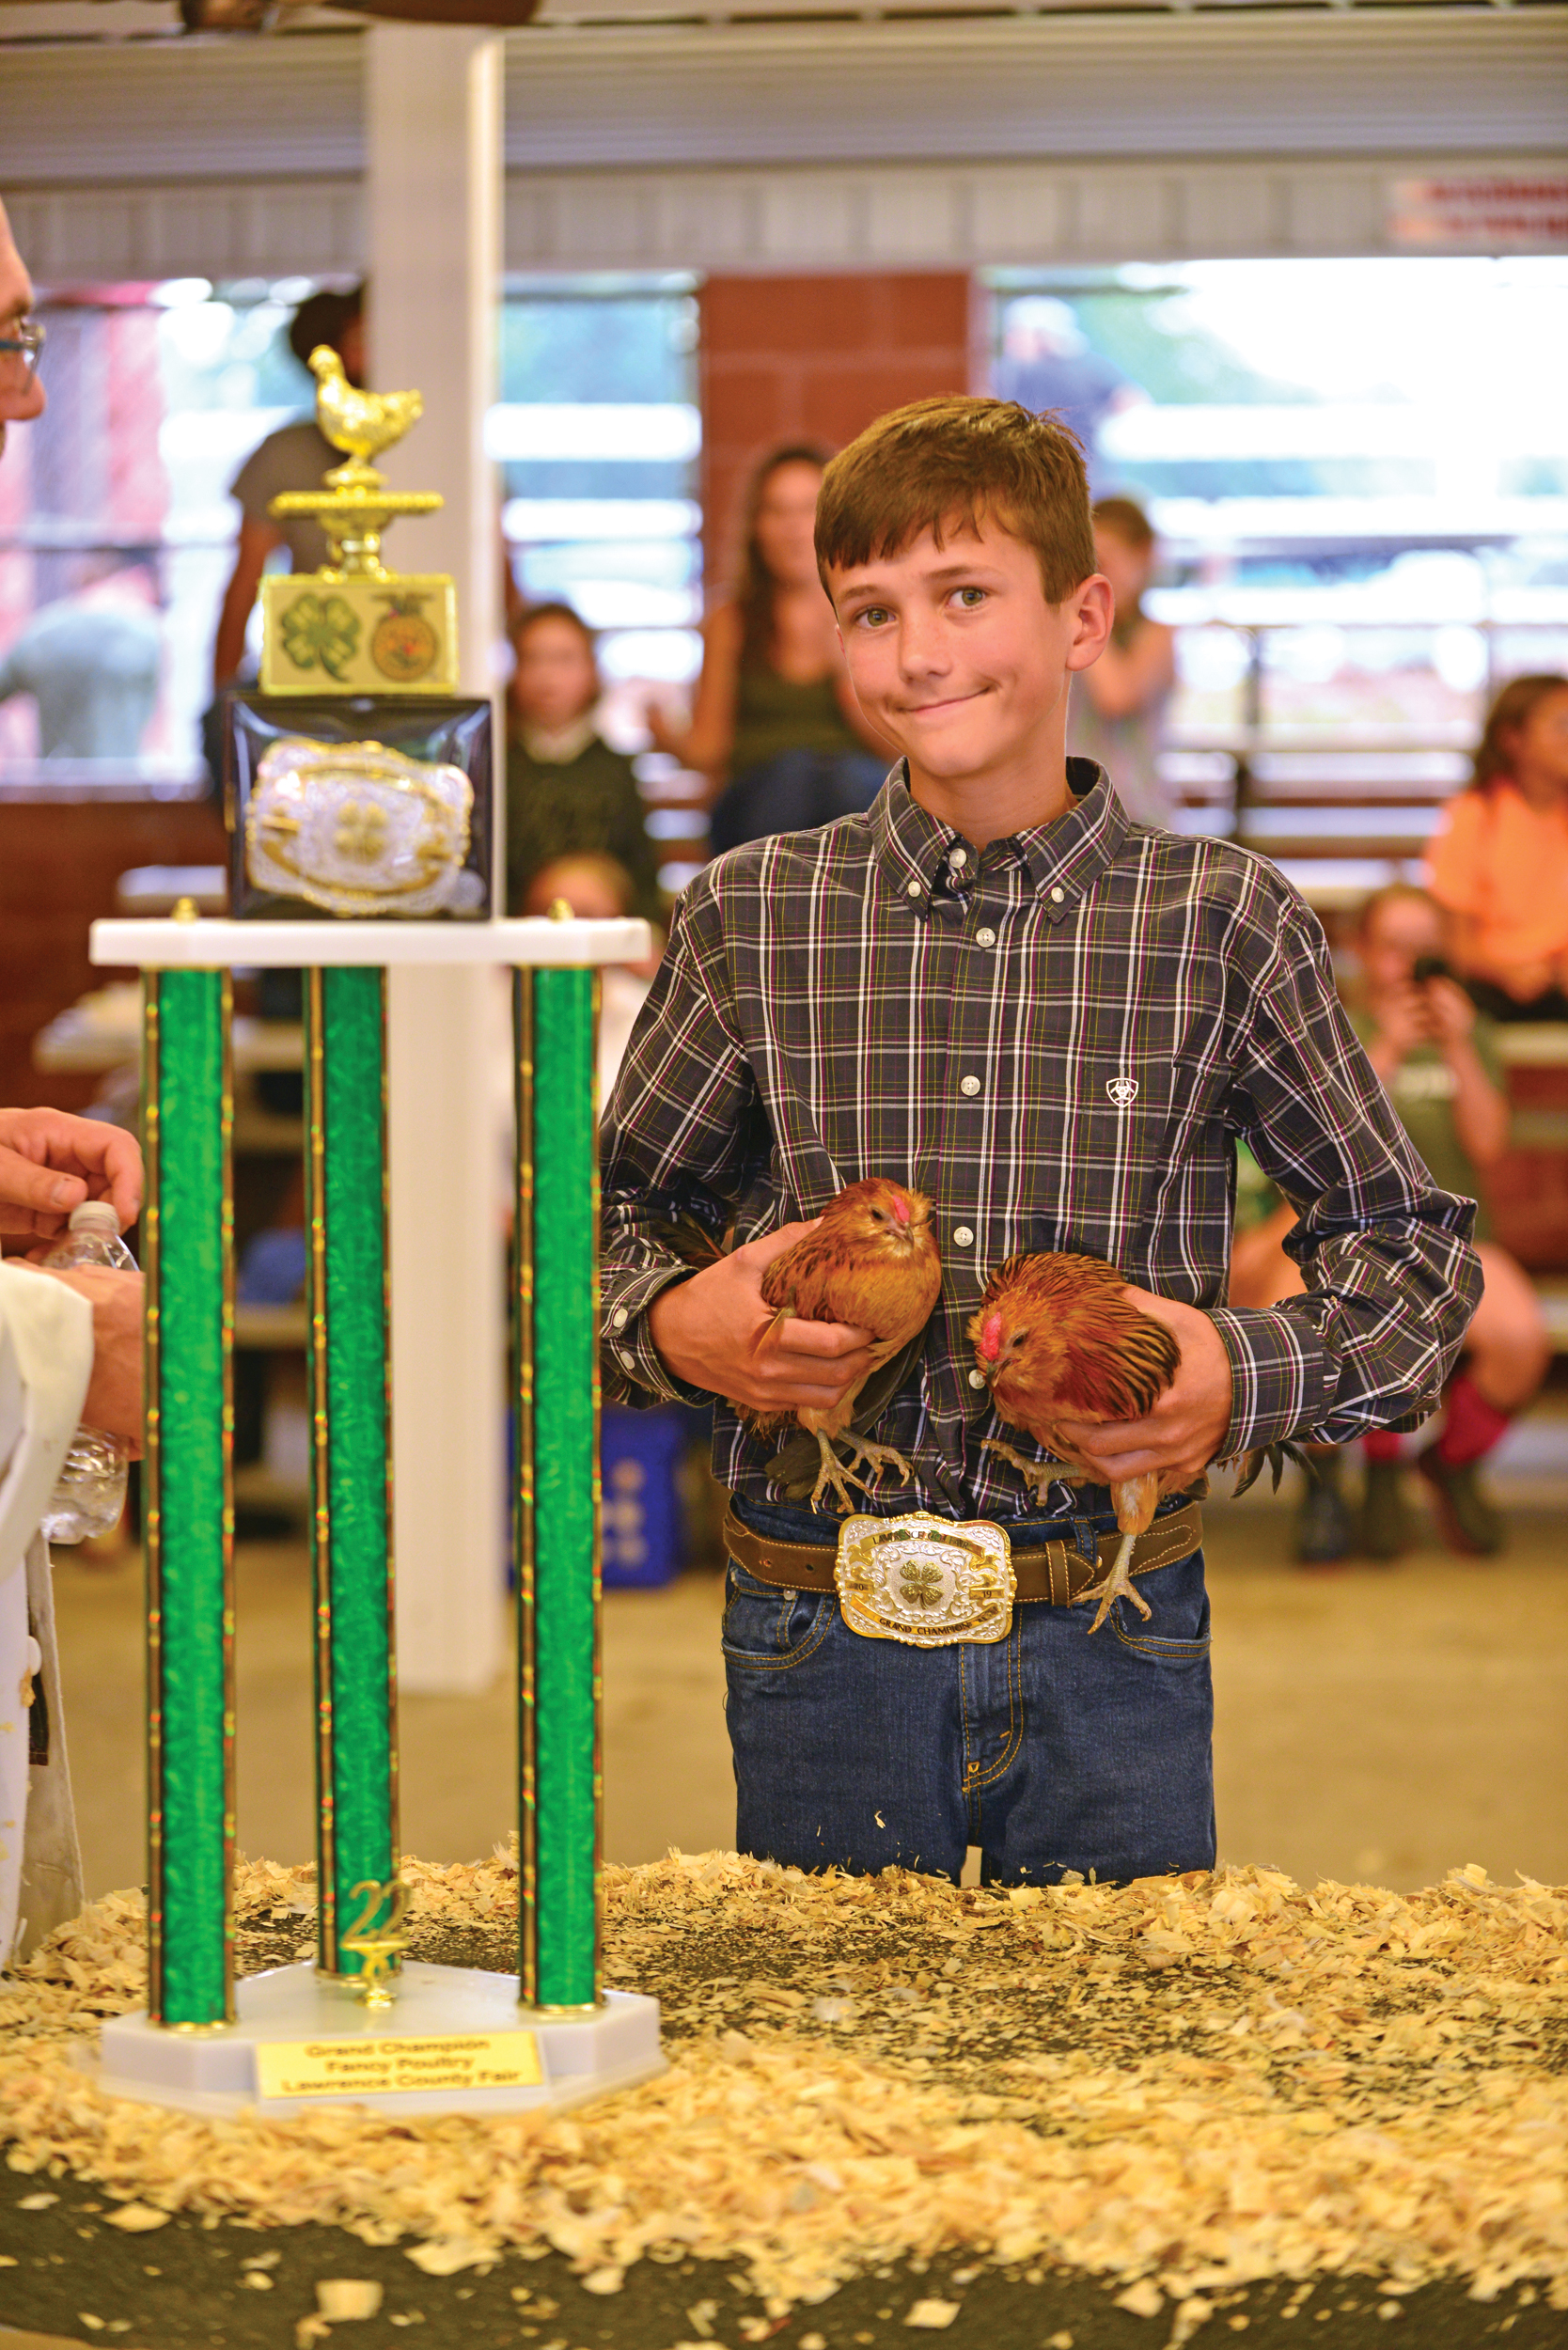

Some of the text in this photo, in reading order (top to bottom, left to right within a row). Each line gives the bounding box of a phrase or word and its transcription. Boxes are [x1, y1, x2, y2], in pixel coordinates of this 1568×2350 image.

[982, 1590, 992, 1598] 19
[879, 1618, 972, 1636] GRAND CHAMPION
[339, 1879, 411, 1945] 22
[306, 2040, 490, 2058] Grand Champion
[325, 2057, 473, 2074] Fancy Poultry
[281, 2070, 521, 2092] Lawrence County Fair
